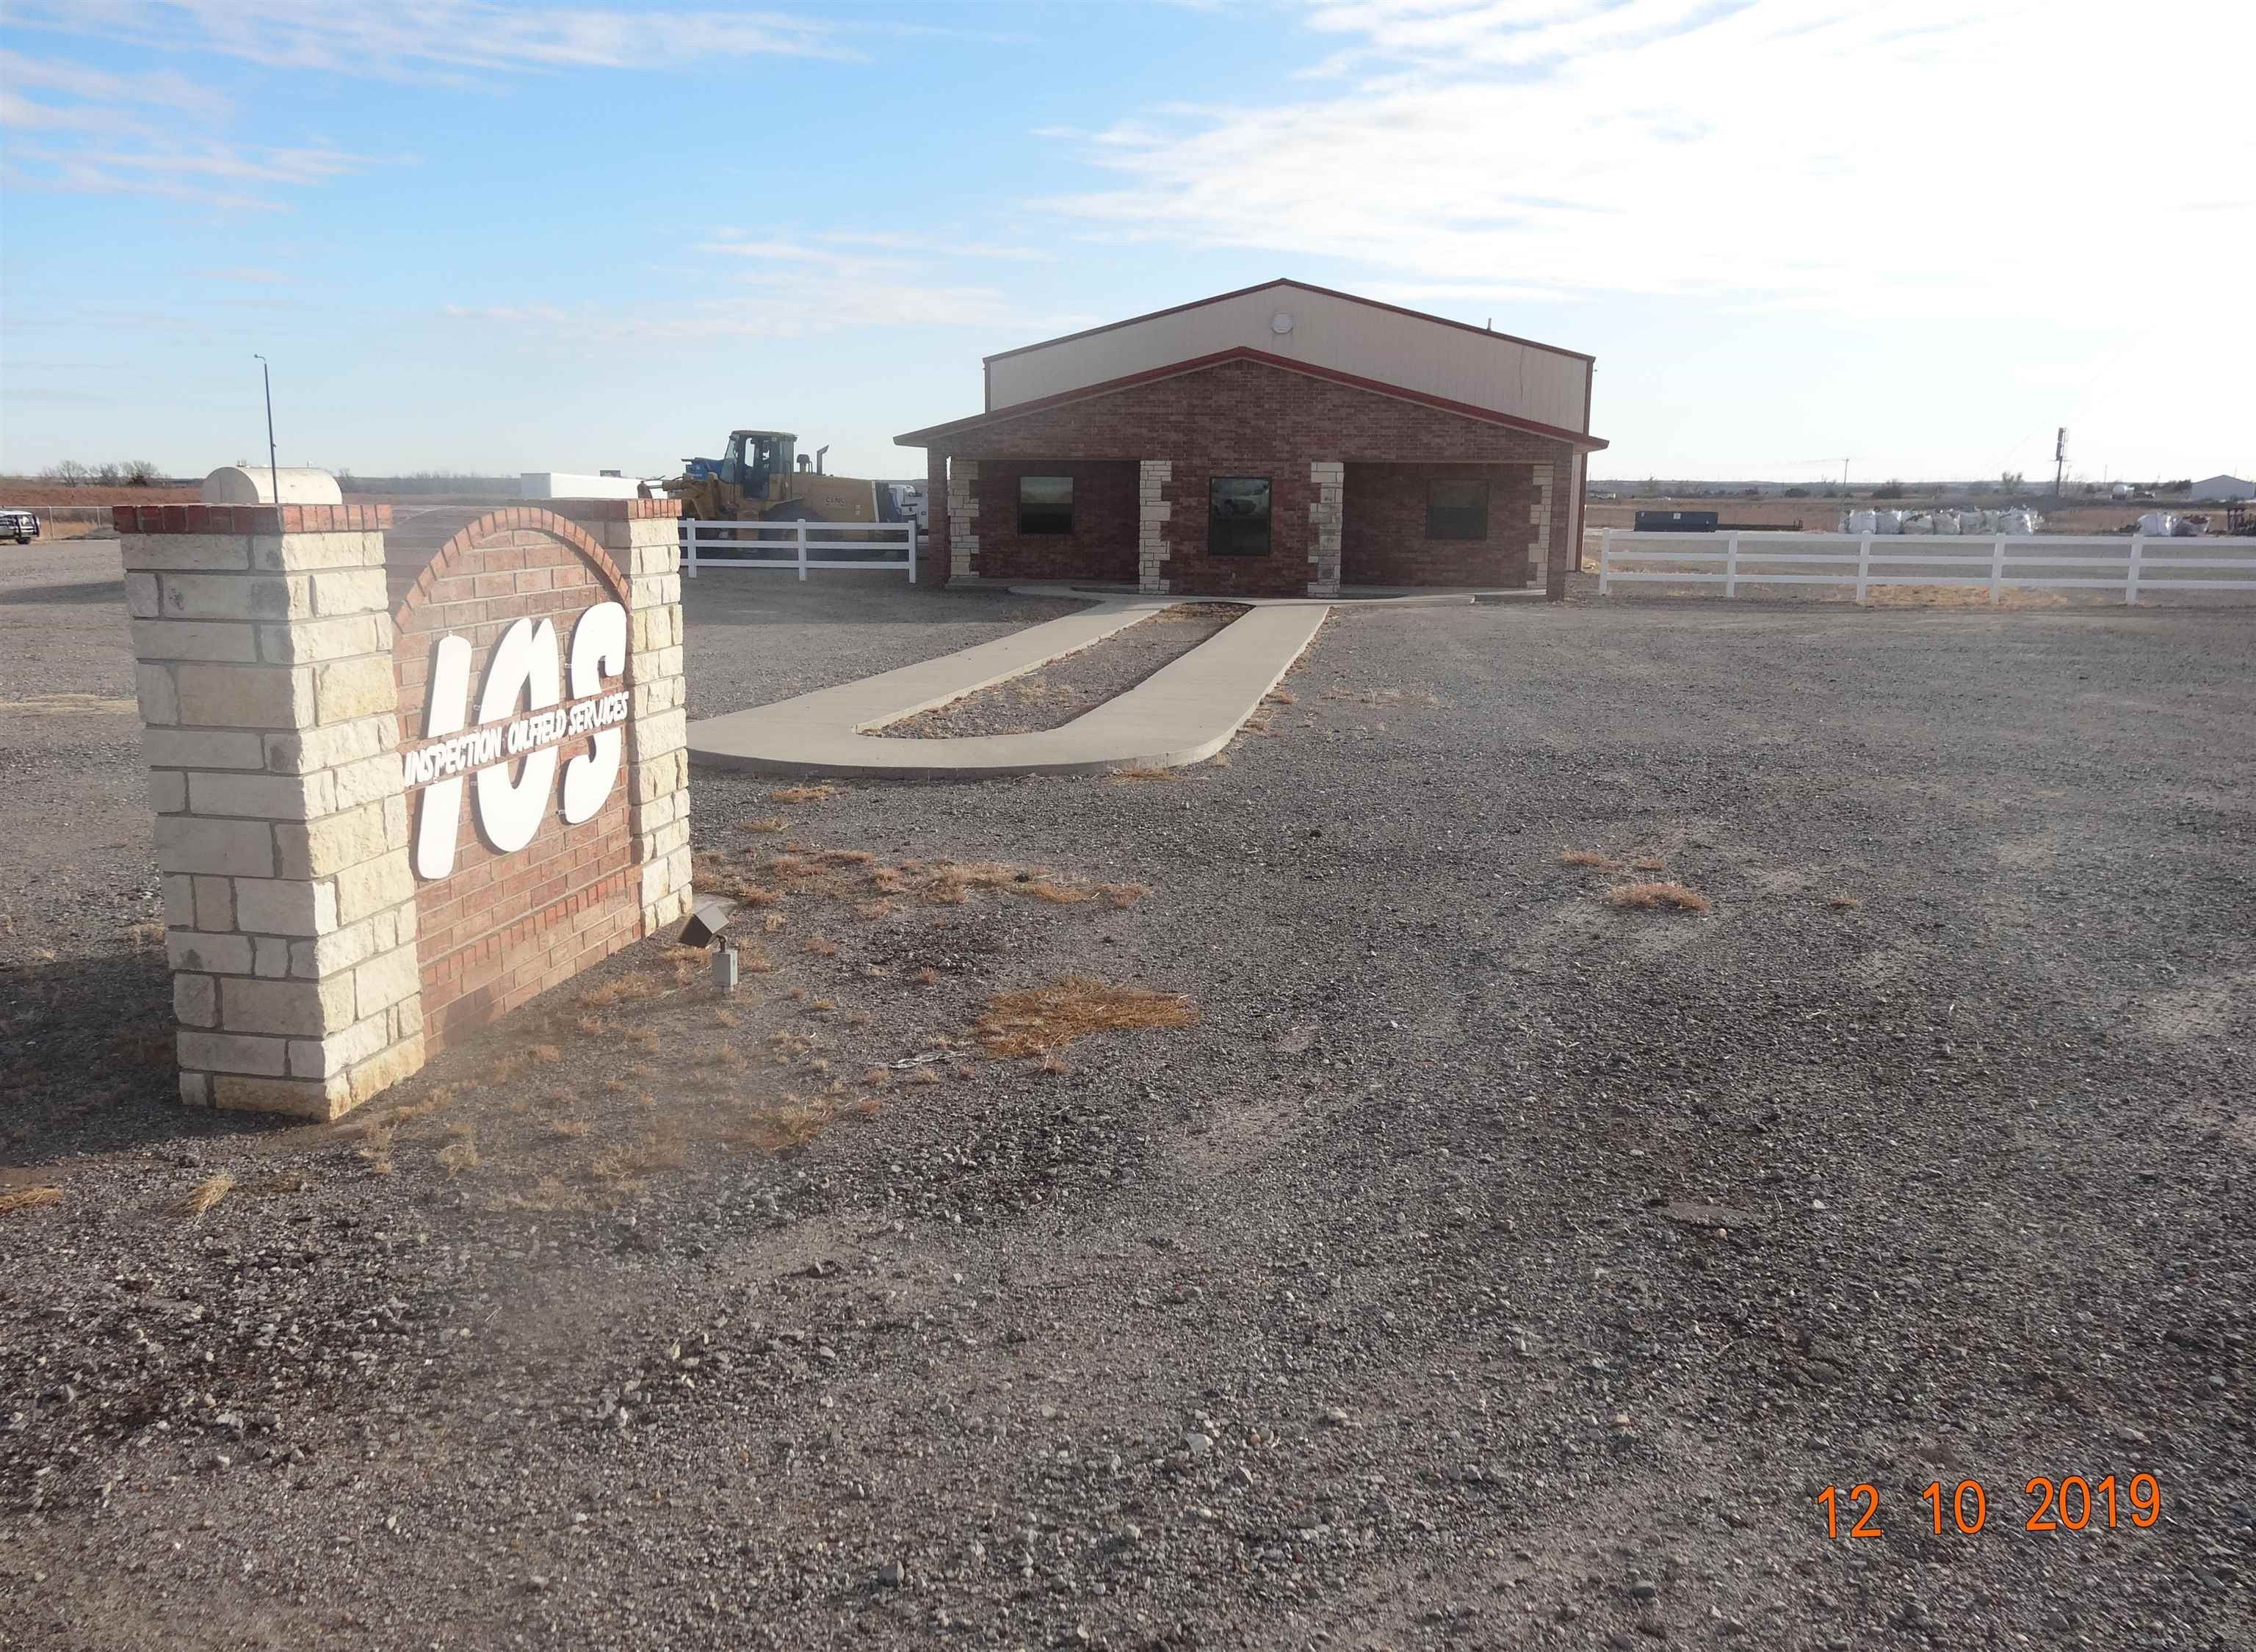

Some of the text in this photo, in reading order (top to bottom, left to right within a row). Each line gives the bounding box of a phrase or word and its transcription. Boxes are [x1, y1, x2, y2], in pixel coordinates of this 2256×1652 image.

[405, 691, 629, 786] INSPECTION OILFIELD SERVICES
